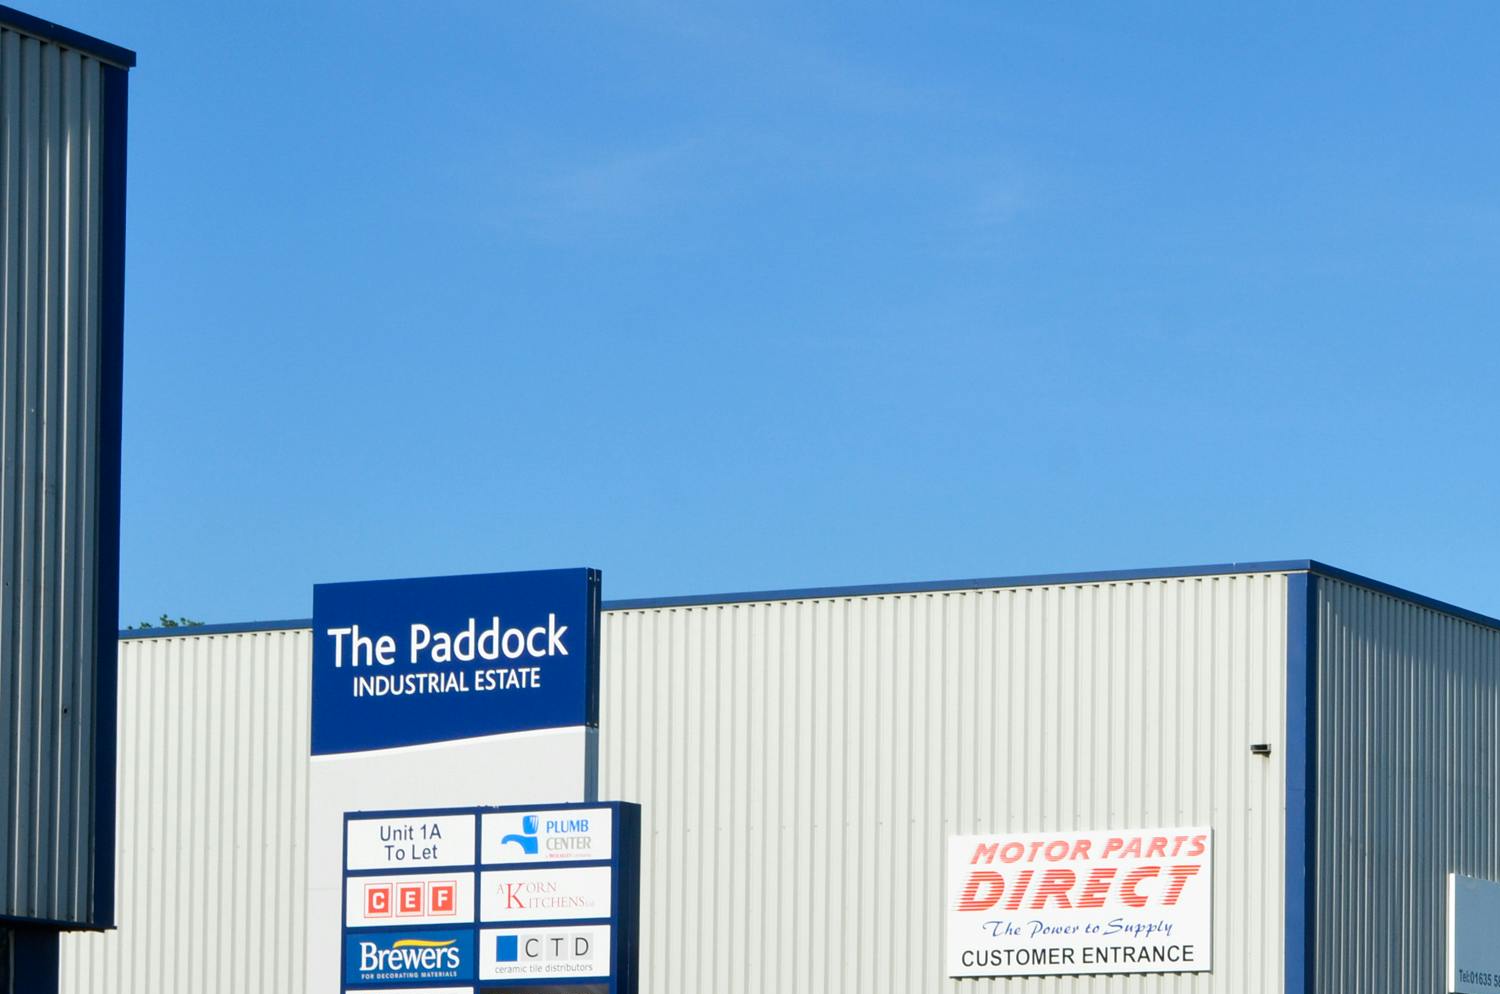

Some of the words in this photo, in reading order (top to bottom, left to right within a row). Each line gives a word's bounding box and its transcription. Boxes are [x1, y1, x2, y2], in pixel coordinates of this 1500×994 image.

[327, 624, 396, 668] The
[410, 613, 569, 664] Paddock
[353, 671, 469, 697] INDUSTRIAL
[475, 667, 541, 691] ESTATE
[380, 824, 414, 841] Unit
[420, 823, 442, 840] 1A
[546, 819, 589, 833] PLUMB
[384, 845, 405, 861] To
[412, 844, 438, 860] Let
[546, 836, 592, 851] CENTER
[970, 839, 1092, 865] MOTOR
[1101, 835, 1208, 860] PARTS
[955, 864, 1202, 912] DIRECT
[982, 919, 1021, 938] The
[1027, 919, 1080, 939] Power
[1085, 922, 1100, 934] to
[1103, 917, 1174, 938] Supply
[359, 942, 460, 971] Brewers
[525, 937, 589, 958] CTD
[961, 947, 1075, 967] CUSTOMER
[1082, 944, 1195, 964] ENTRANCE
[376, 971, 419, 979] DECORATING
[421, 970, 458, 978] MATERIALS
[495, 965, 527, 974] ceramic
[529, 964, 543, 972] tile
[545, 962, 593, 973] distributors
